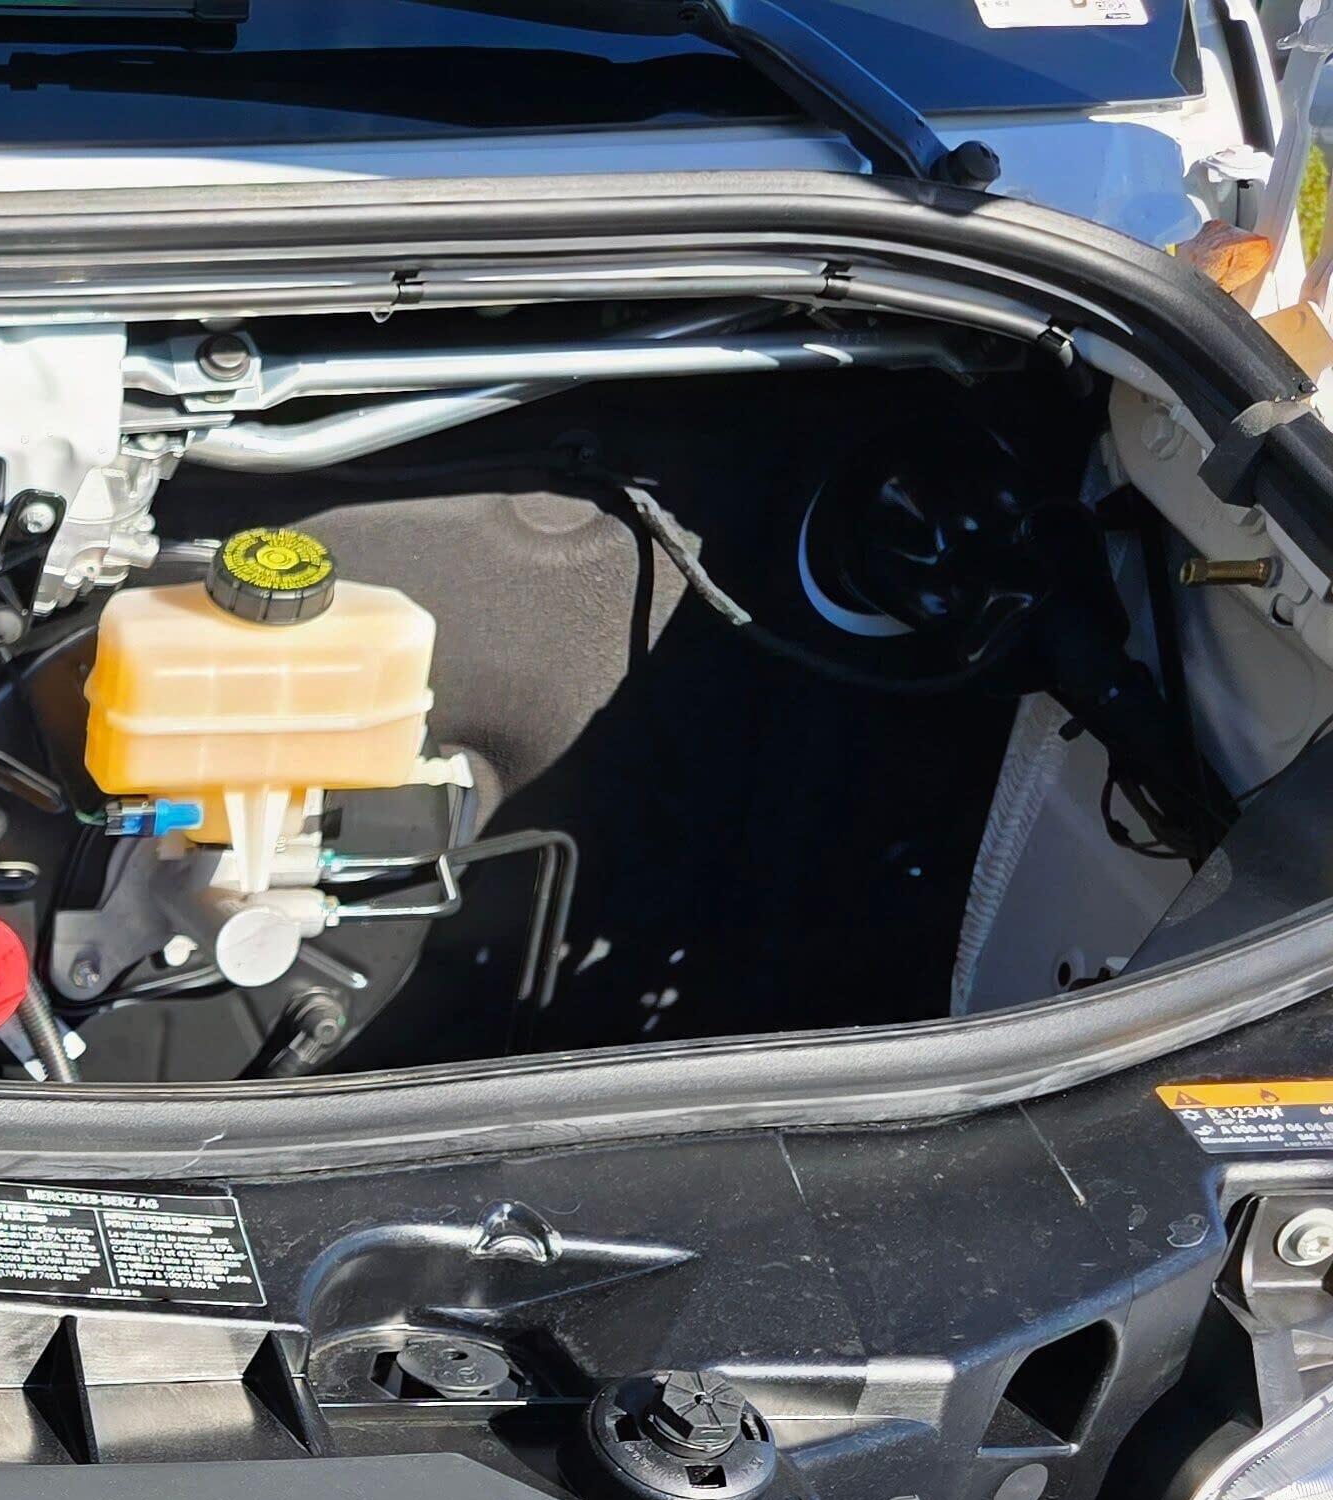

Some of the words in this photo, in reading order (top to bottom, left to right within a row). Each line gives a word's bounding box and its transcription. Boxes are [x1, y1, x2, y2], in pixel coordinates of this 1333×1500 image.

[1205, 1105, 1285, 1120] R-1234yf
[26, 1189, 137, 1208] MERCEDES-BENZ
[138, 1198, 160, 1209] AG
[10, 1224, 27, 1232] and
[28, 1225, 56, 1235] engine
[107, 1230, 119, 1239] Le
[157, 1233, 166, 1241] et
[177, 1235, 208, 1243] moteur
[21, 1241, 69, 1251] regulations
[80, 1243, 96, 1252] the
[50, 1248, 63, 1257] for
[65, 1250, 100, 1260] vehicles
[189, 1251, 222, 1260] Canada
[36, 1256, 64, 1265] GVWR
[66, 1258, 82, 1266] and
[83, 1259, 100, 1267] has
[58, 1265, 90, 1274] vehicle
[27, 1271, 37, 1279] of
[38, 1272, 62, 1280] 7400
[164, 1271, 192, 1280] 10000
[183, 1280, 207, 1289] 7400
